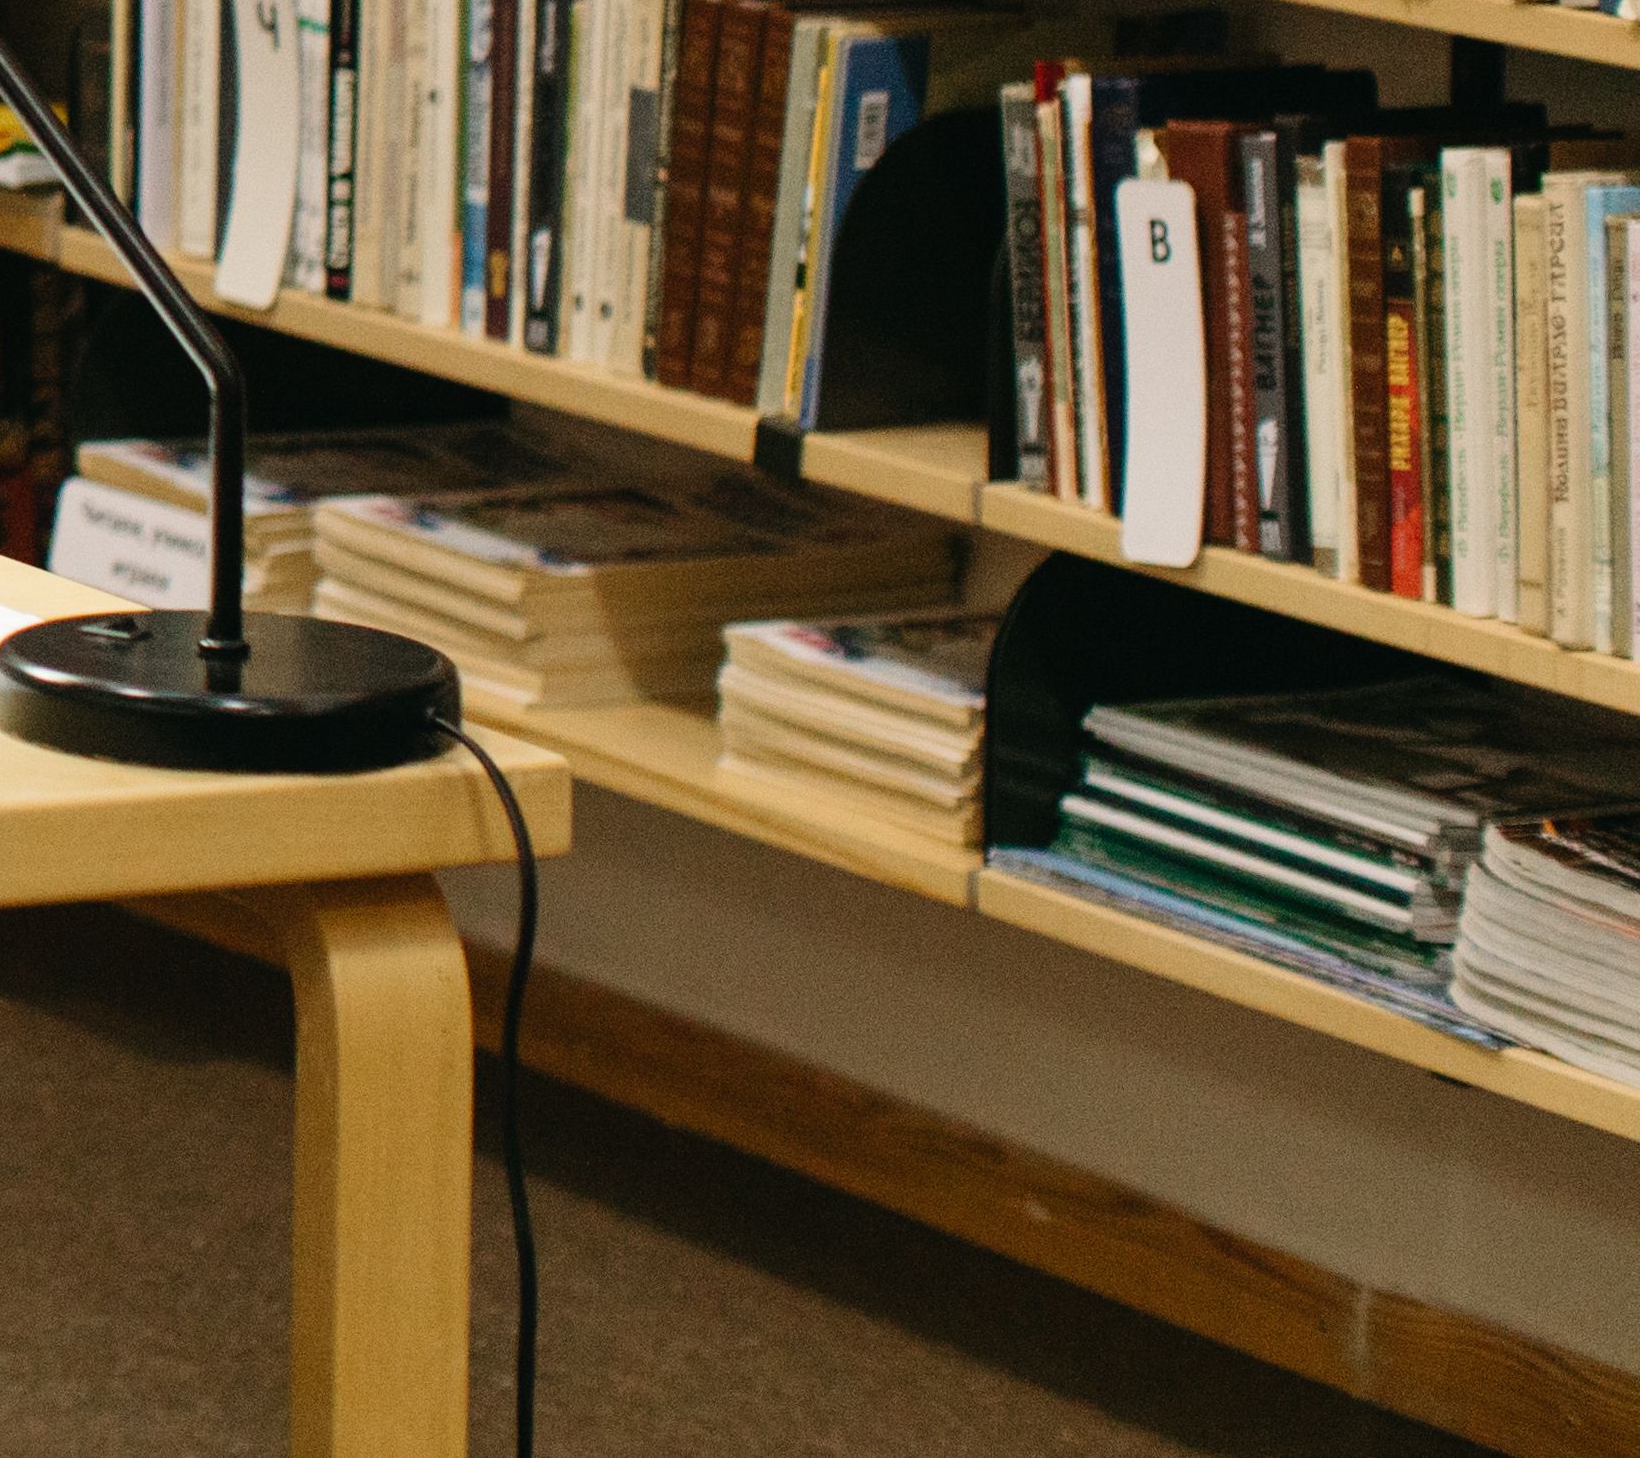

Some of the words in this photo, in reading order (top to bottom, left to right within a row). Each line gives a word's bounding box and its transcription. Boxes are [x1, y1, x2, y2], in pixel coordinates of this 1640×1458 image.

[1148, 218, 1173, 265] В
[1251, 273, 1280, 393] ВАГНЕР
[1387, 315, 1411, 388] ВАГНЕР
[1390, 396, 1413, 473] РИХАРД
